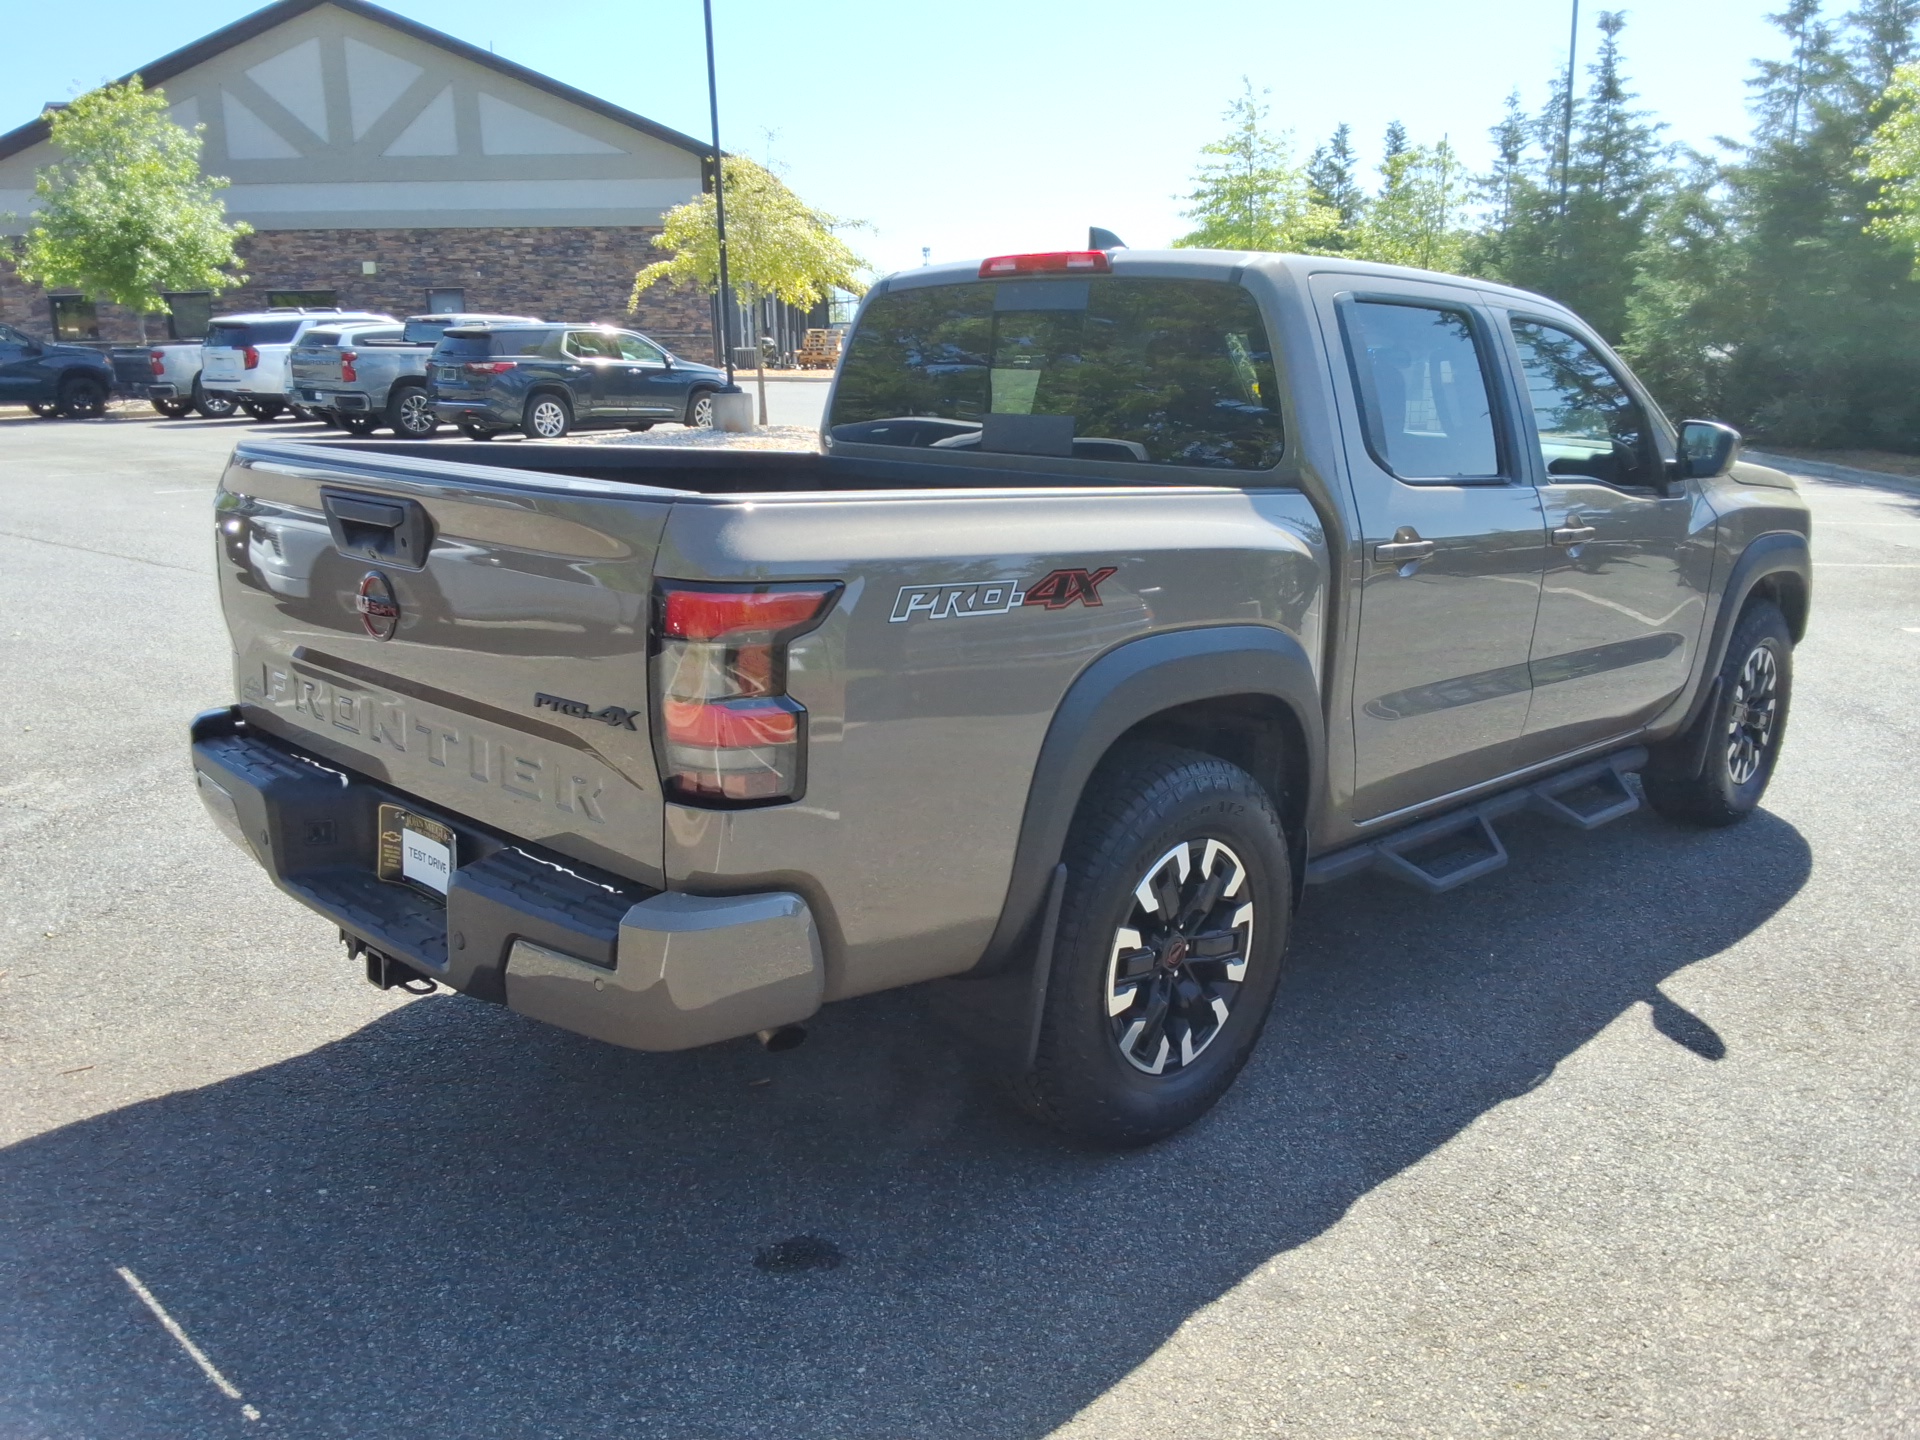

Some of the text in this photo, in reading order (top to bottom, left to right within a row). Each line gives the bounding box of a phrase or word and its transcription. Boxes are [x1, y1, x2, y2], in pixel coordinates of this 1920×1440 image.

[262, 661, 605, 825] FRONTIER
[408, 846, 427, 863] TEST
[427, 855, 447, 874] DRIVE
